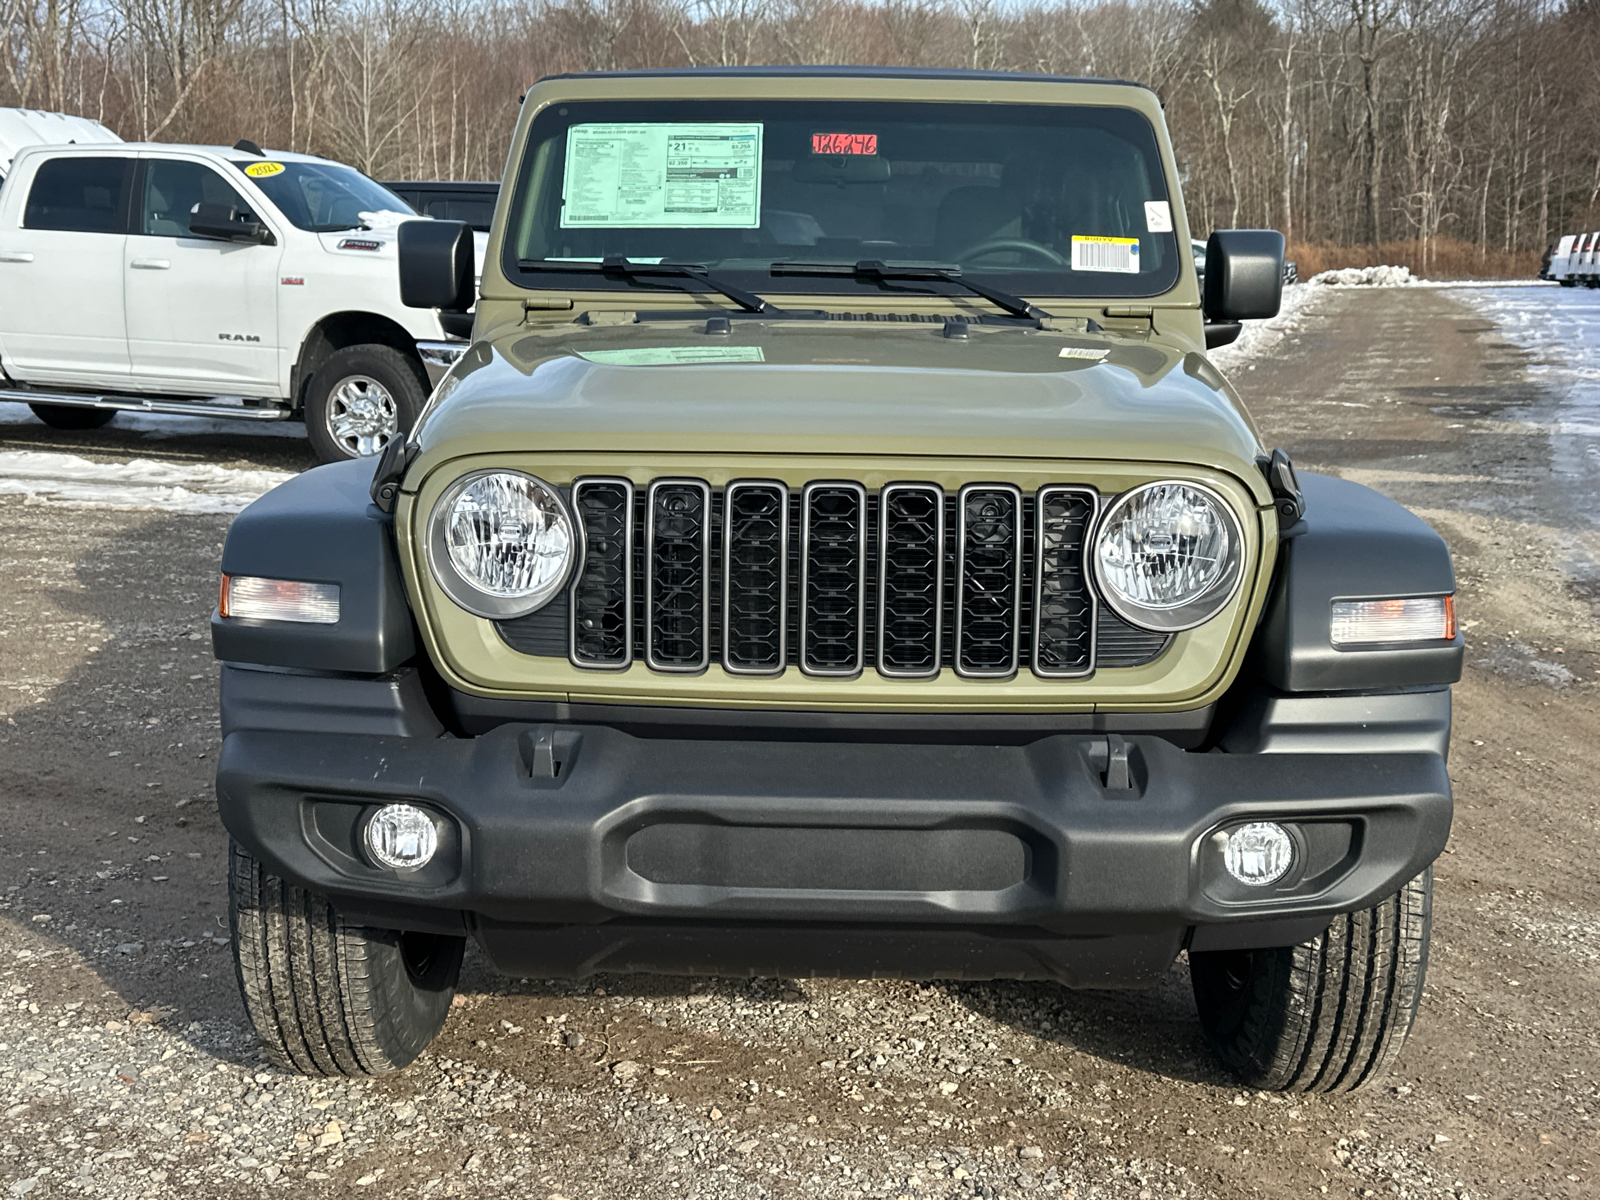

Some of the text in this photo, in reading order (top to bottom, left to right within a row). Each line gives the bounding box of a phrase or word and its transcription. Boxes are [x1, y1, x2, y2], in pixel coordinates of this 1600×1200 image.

[674, 142, 686, 151] 21
[252, 163, 279, 177] 2021
[218, 333, 261, 342] RAM
